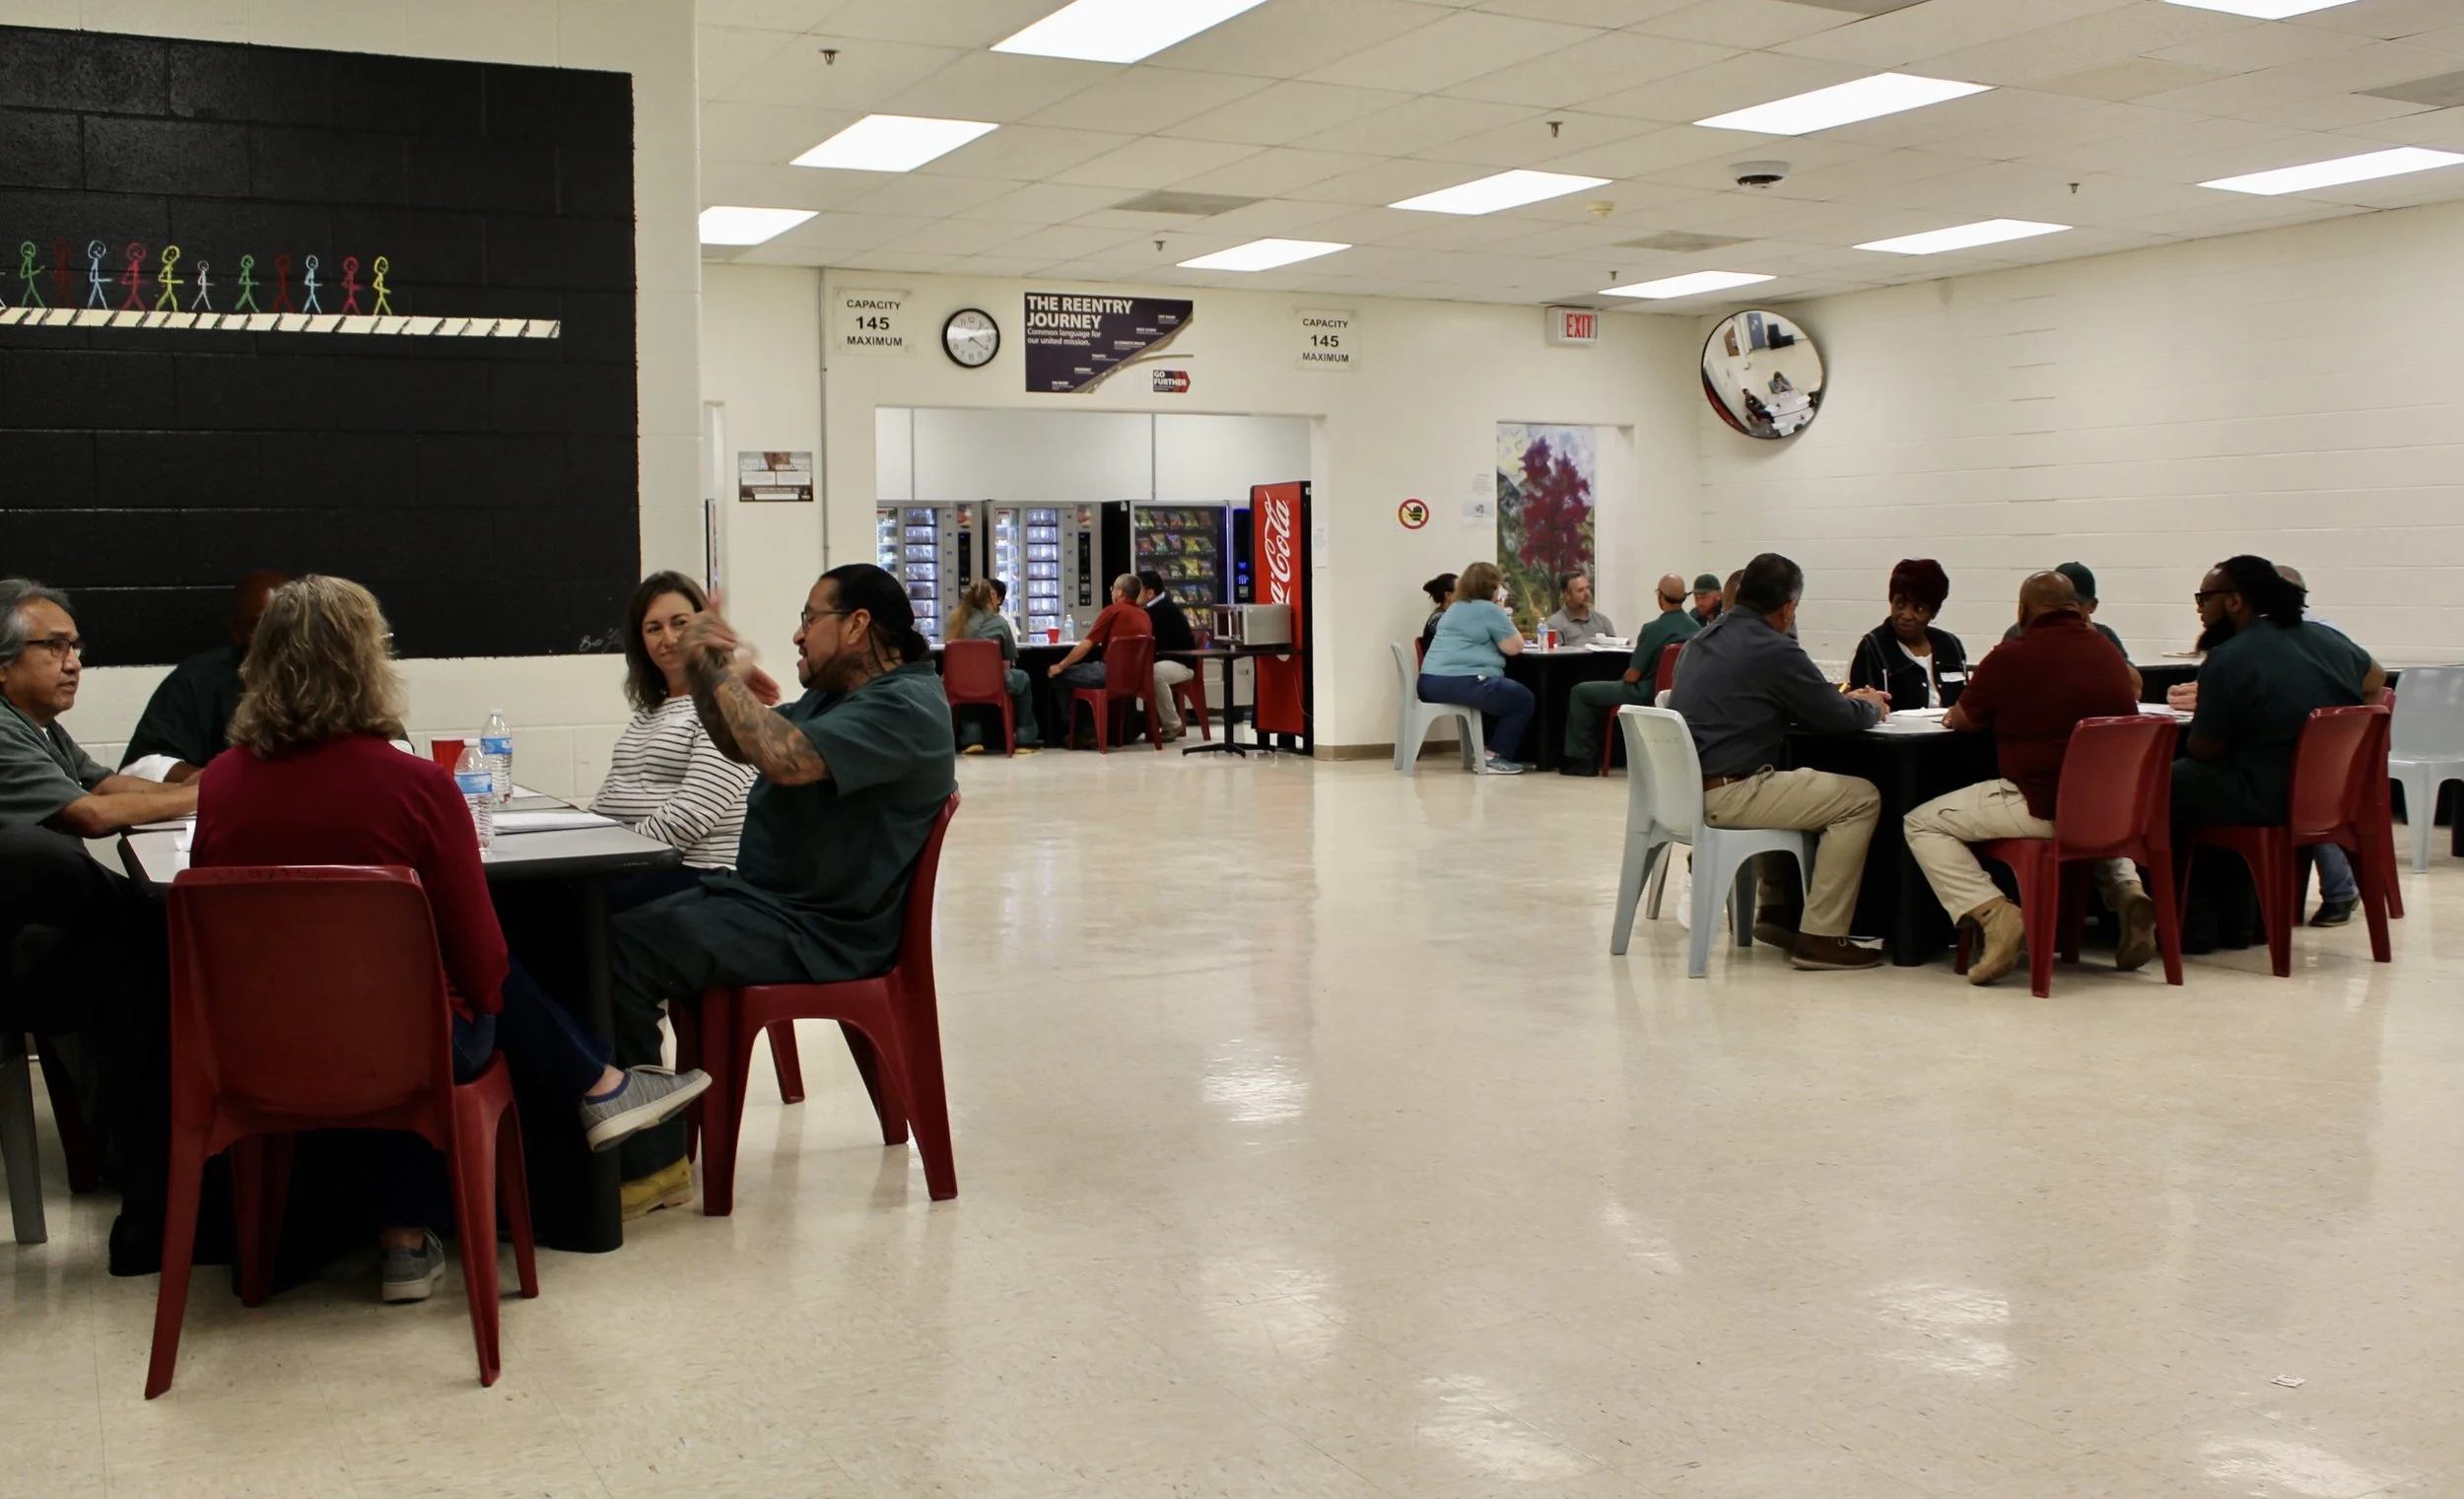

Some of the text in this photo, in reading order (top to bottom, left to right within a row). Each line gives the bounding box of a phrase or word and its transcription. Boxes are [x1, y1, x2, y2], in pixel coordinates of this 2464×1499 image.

[847, 300, 901, 309] CAPACITY
[1027, 296, 1132, 314] THE REENTRY
[856, 316, 890, 330] 145
[1027, 313, 1102, 328] JOURNEY
[1303, 318, 1348, 328] CAPACITY
[1566, 313, 1593, 338] EXIT
[1060, 329, 1090, 339] language
[847, 335, 903, 346] MAXIMUM
[1311, 334, 1339, 347] 145
[1303, 353, 1348, 363] MAXIMUM
